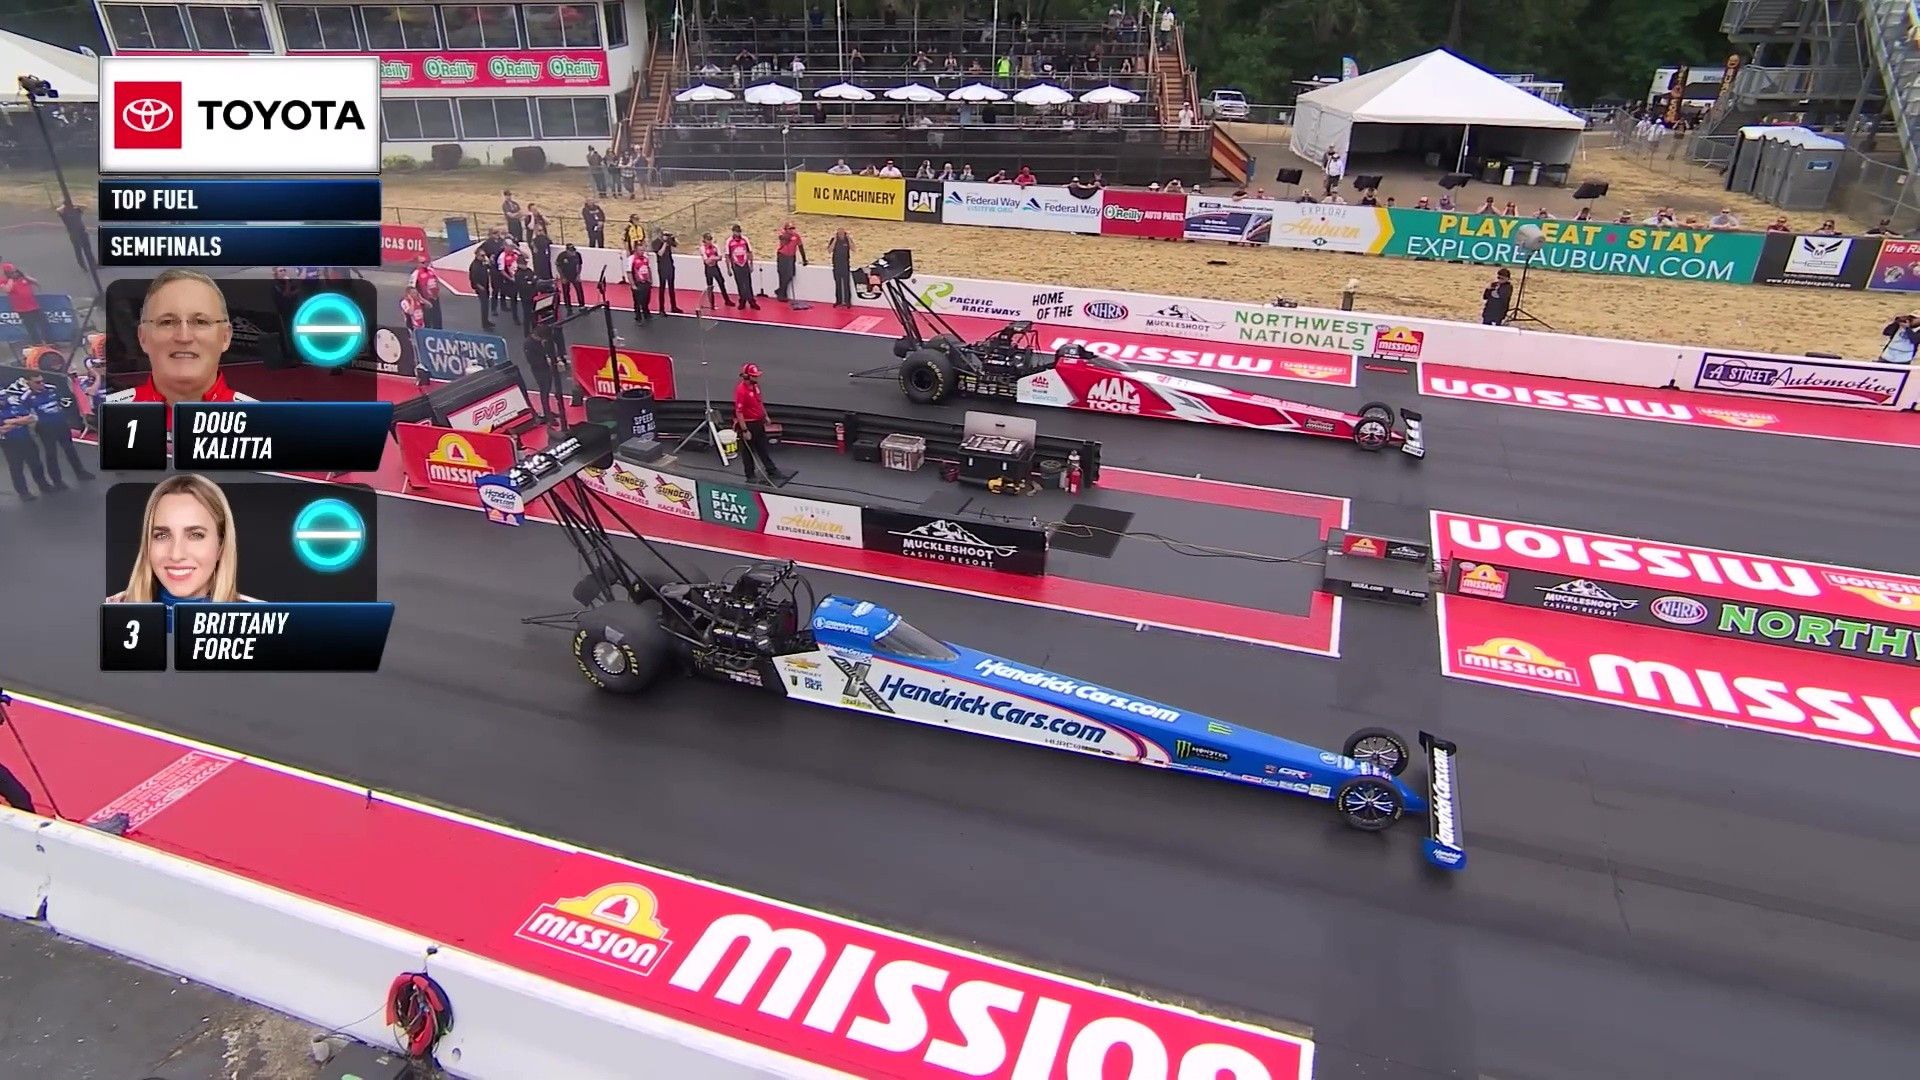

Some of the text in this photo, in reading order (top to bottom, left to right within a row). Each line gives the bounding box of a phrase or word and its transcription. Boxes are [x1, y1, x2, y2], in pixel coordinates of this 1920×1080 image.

[380, 61, 410, 80] Reilly
[425, 58, 476, 79] O'Reilly
[490, 58, 541, 79] O'Reilly
[549, 58, 600, 79] O'Reilly
[833, 189, 896, 206] MACHINERY
[907, 190, 941, 213] CAT
[966, 195, 1020, 209] Federal Way
[1045, 203, 1079, 213] Federal
[1080, 205, 1100, 217] Way
[1104, 204, 1143, 223] O'Reilly
[1144, 210, 1162, 220] AUTO
[1162, 211, 1184, 221] PARTS
[1302, 206, 1347, 219] EXPLORE
[1281, 217, 1360, 239] Auburn
[1439, 215, 1714, 253] PLAY EAT STAY
[380, 237, 424, 251] UCAS OIL
[1885, 243, 1904, 254] the
[1407, 235, 1735, 282] EXPLOREAUBURN.COM
[949, 296, 994, 307] PACIFIC
[1033, 291, 1065, 306] HOME
[961, 304, 1021, 317] RACEWAYS
[1037, 305, 1074, 320] OF THE
[1090, 302, 1123, 319] NHRA
[1146, 319, 1210, 332] MUCKLESHOOT
[1235, 310, 1374, 336] NORTHWEST
[425, 336, 498, 360] CAMPING
[1239, 327, 1366, 351] NATIONALS
[1708, 365, 1897, 394] A STREET Automotive
[1087, 377, 1140, 405] MAC
[1430, 377, 1694, 421] MISSION
[472, 398, 508, 426] FVP
[1087, 399, 1141, 414] TOOLS
[614, 473, 646, 488] SUNOCO
[485, 488, 517, 501] Hendrick
[656, 485, 693, 500] SUNOCO
[711, 489, 738, 502] EAT
[712, 500, 747, 515] PLAY
[713, 511, 748, 525] STAY
[776, 524, 851, 541] EXPLOREAUBURN.COM
[902, 537, 995, 561] MUCKLESHOOT
[1449, 519, 1821, 598] MISSION
[902, 550, 995, 568] CASINO RESORT
[1463, 578, 1502, 592] MISSION
[1827, 574, 1920, 594] ISSION
[1543, 601, 1618, 618] CASINO RESORT
[1545, 593, 1620, 612] MUCKLESHOOT
[1660, 602, 1699, 618] NHRA
[1463, 652, 1574, 683] MISSION
[975, 658, 1180, 723] HendrickCars.com
[878, 674, 1107, 743] HendrickCars.com
[1589, 653, 1920, 749] MISSI
[527, 911, 661, 970] MISSION
